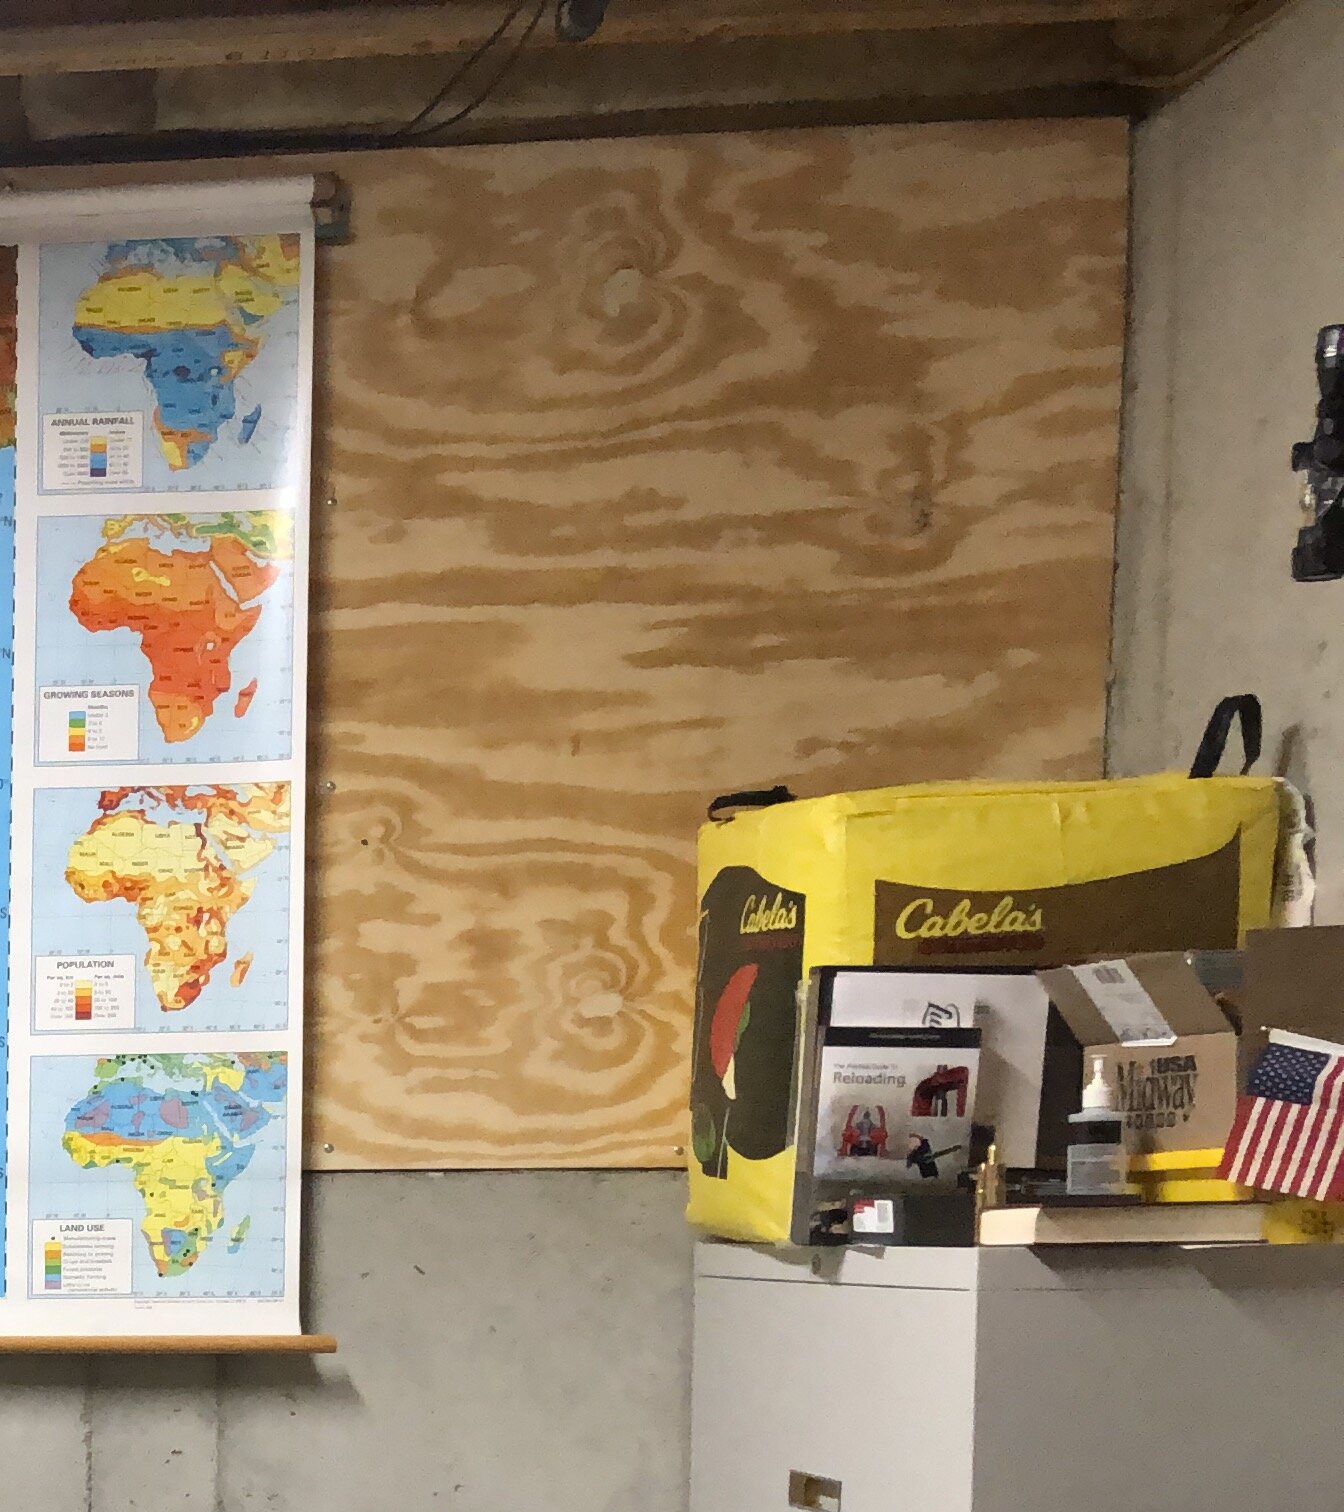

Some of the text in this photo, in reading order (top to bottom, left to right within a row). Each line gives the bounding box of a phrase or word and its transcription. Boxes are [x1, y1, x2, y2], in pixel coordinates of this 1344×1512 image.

[51, 417, 134, 426] ANNUAL RAINFALL
[43, 690, 134, 699] GROWING SEASONS
[740, 892, 798, 935] Cabela's
[895, 895, 1044, 940] Cabela's
[56, 960, 115, 969] POPULATION
[832, 1071, 906, 1088] Reloading
[59, 1224, 105, 1232] LAND USE
